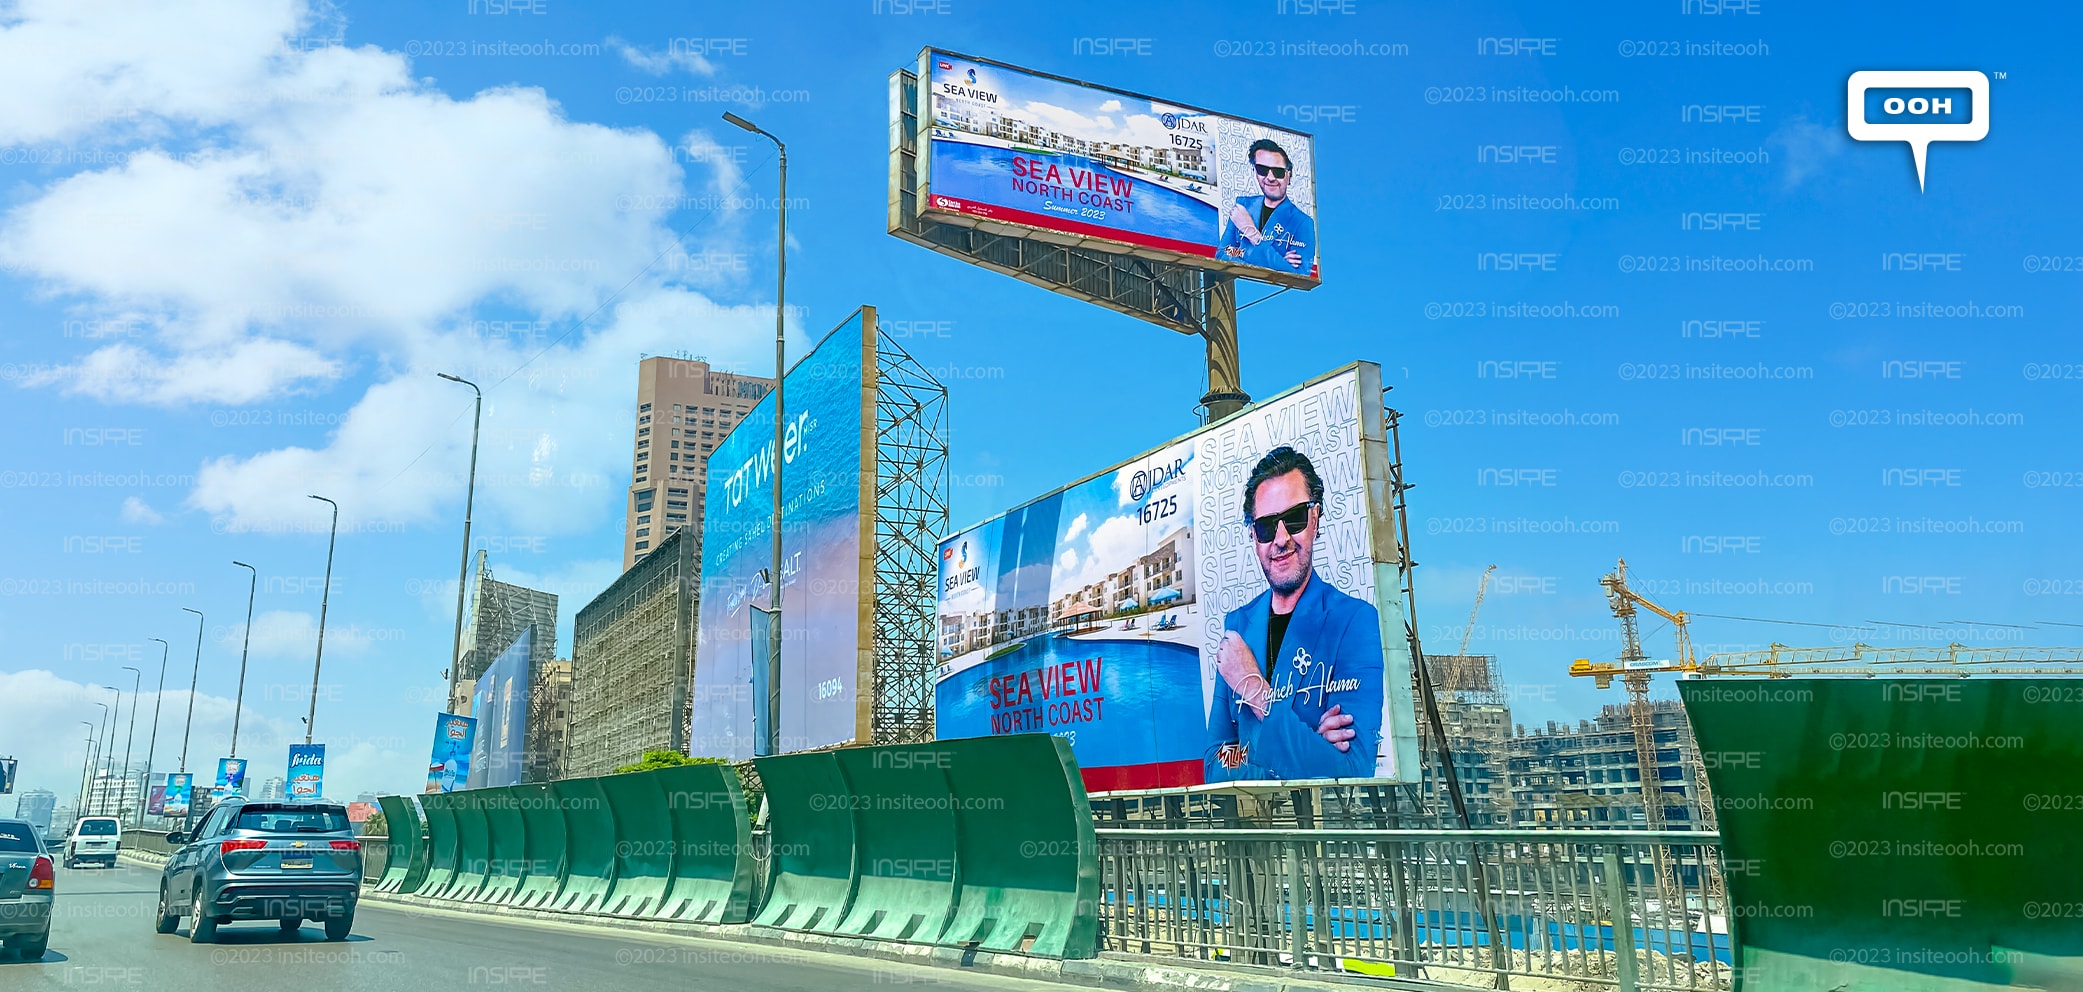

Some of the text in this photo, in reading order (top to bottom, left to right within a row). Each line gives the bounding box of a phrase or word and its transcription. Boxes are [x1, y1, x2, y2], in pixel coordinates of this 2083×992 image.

[943, 83, 997, 103] SEA VIEW
[1169, 134, 1203, 150] 16725
[1012, 157, 1133, 198] SEA VIEW
[1012, 177, 1135, 213] NORTH COAST
[1043, 201, 1106, 220] Summer 2023
[1200, 422, 1258, 473] SEA
[1264, 380, 1357, 446] VIEW
[1137, 495, 1177, 526] 16725
[716, 535, 743, 566] CREATING
[744, 521, 765, 546] SAHEL
[780, 552, 802, 579] ALT.
[945, 565, 980, 592] SEA VIEW
[1202, 546, 1262, 593] SEA
[818, 676, 843, 700] 16094
[989, 657, 1103, 710] SEA VIEW
[1232, 661, 1361, 717] Ragheb Alama
[990, 697, 1104, 734] NORTH COAST
